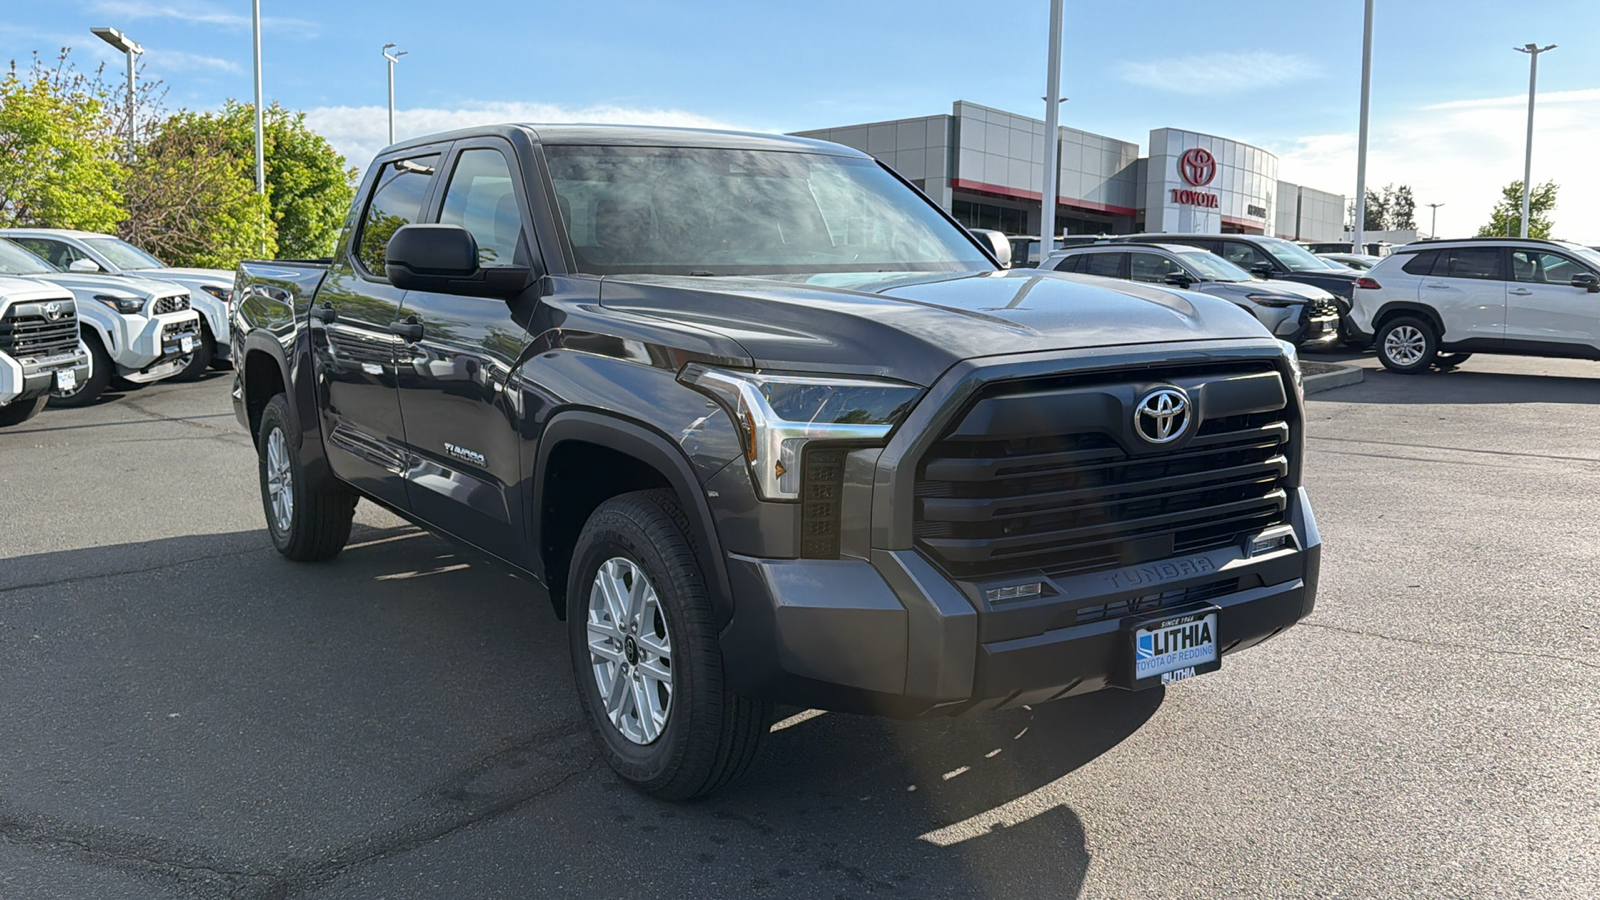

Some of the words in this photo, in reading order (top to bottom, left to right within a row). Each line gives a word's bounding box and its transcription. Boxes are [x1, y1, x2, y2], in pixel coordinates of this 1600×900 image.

[1172, 188, 1219, 208] TOYOTA
[1104, 556, 1215, 588] TUNDRA
[1161, 618, 1180, 628] SINCE
[1154, 622, 1212, 656] LITHIA
[1136, 656, 1165, 672] TOYOTA
[1166, 653, 1177, 664] OF
[1179, 645, 1213, 661] REDDING
[1169, 666, 1196, 681] LITHIA
